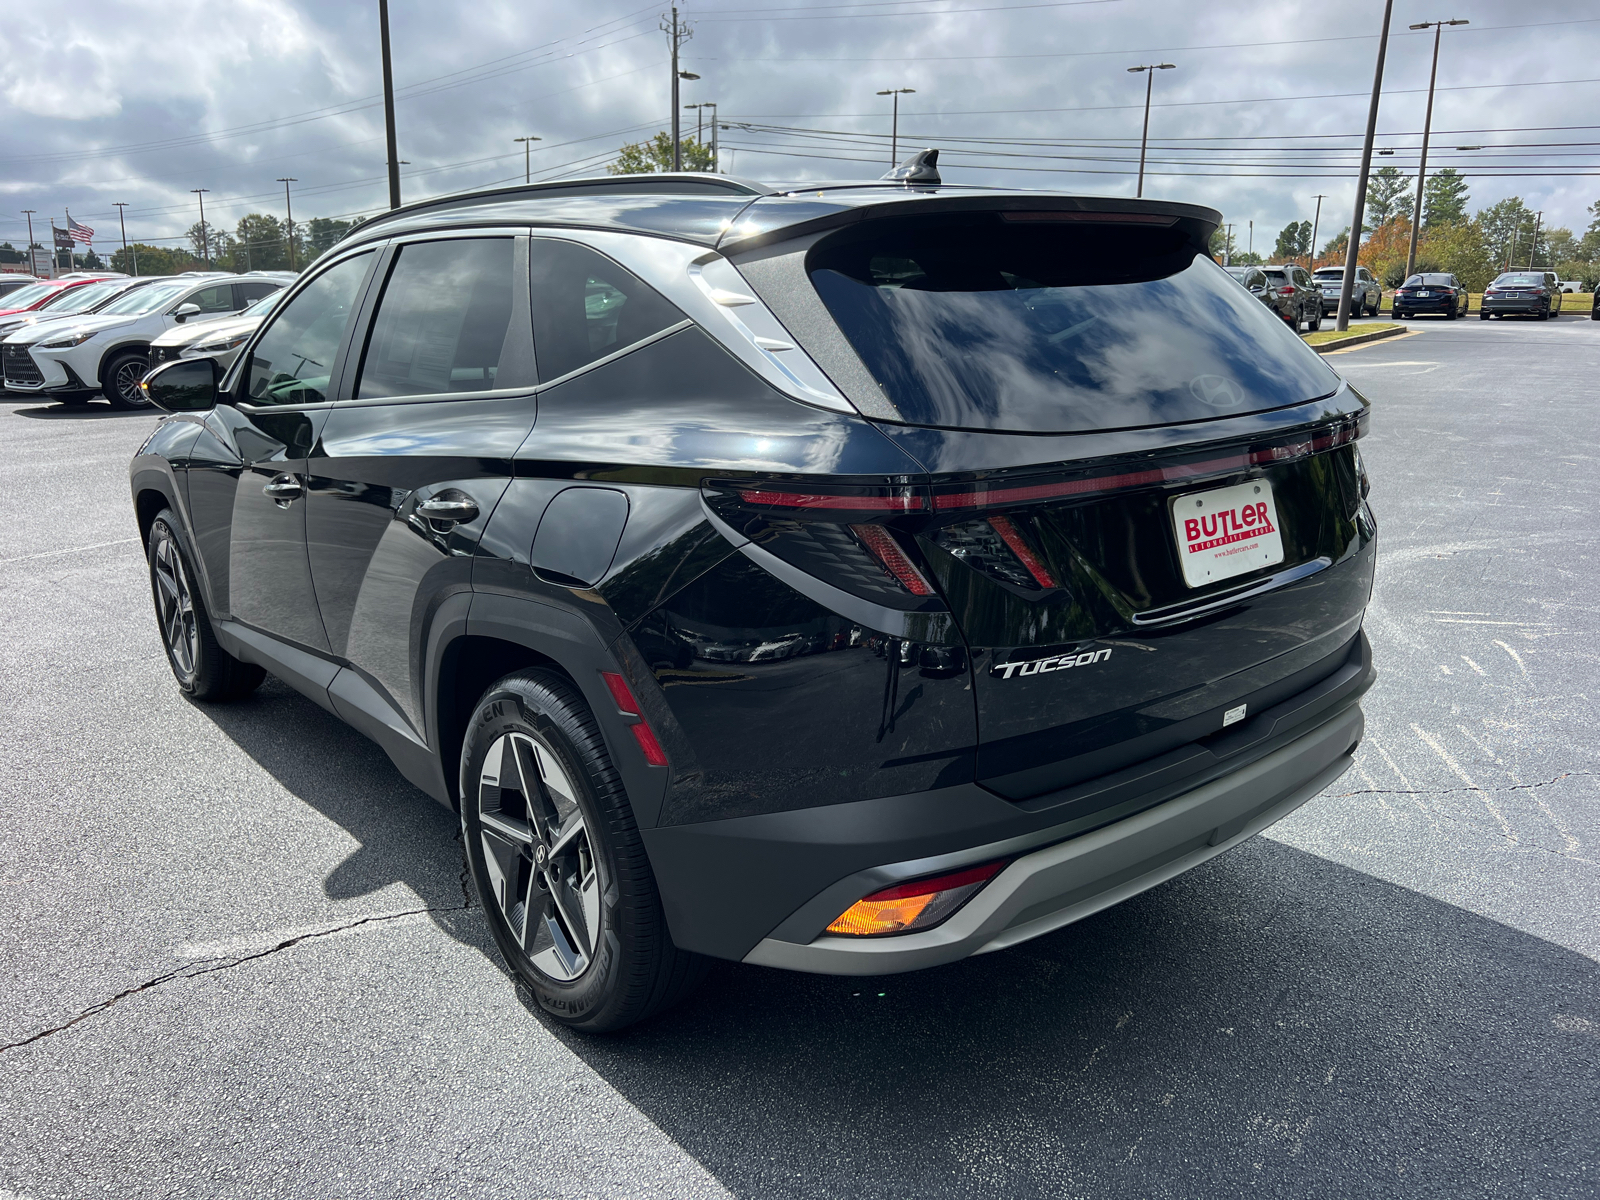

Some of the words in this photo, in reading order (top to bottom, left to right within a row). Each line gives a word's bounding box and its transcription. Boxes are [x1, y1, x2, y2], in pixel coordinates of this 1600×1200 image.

[1189, 533, 1242, 552] AUTOMOTIVE
[1249, 525, 1274, 537] GROUP
[1214, 543, 1259, 559] www.butlercars.com
[994, 648, 1112, 679] TUCSON
